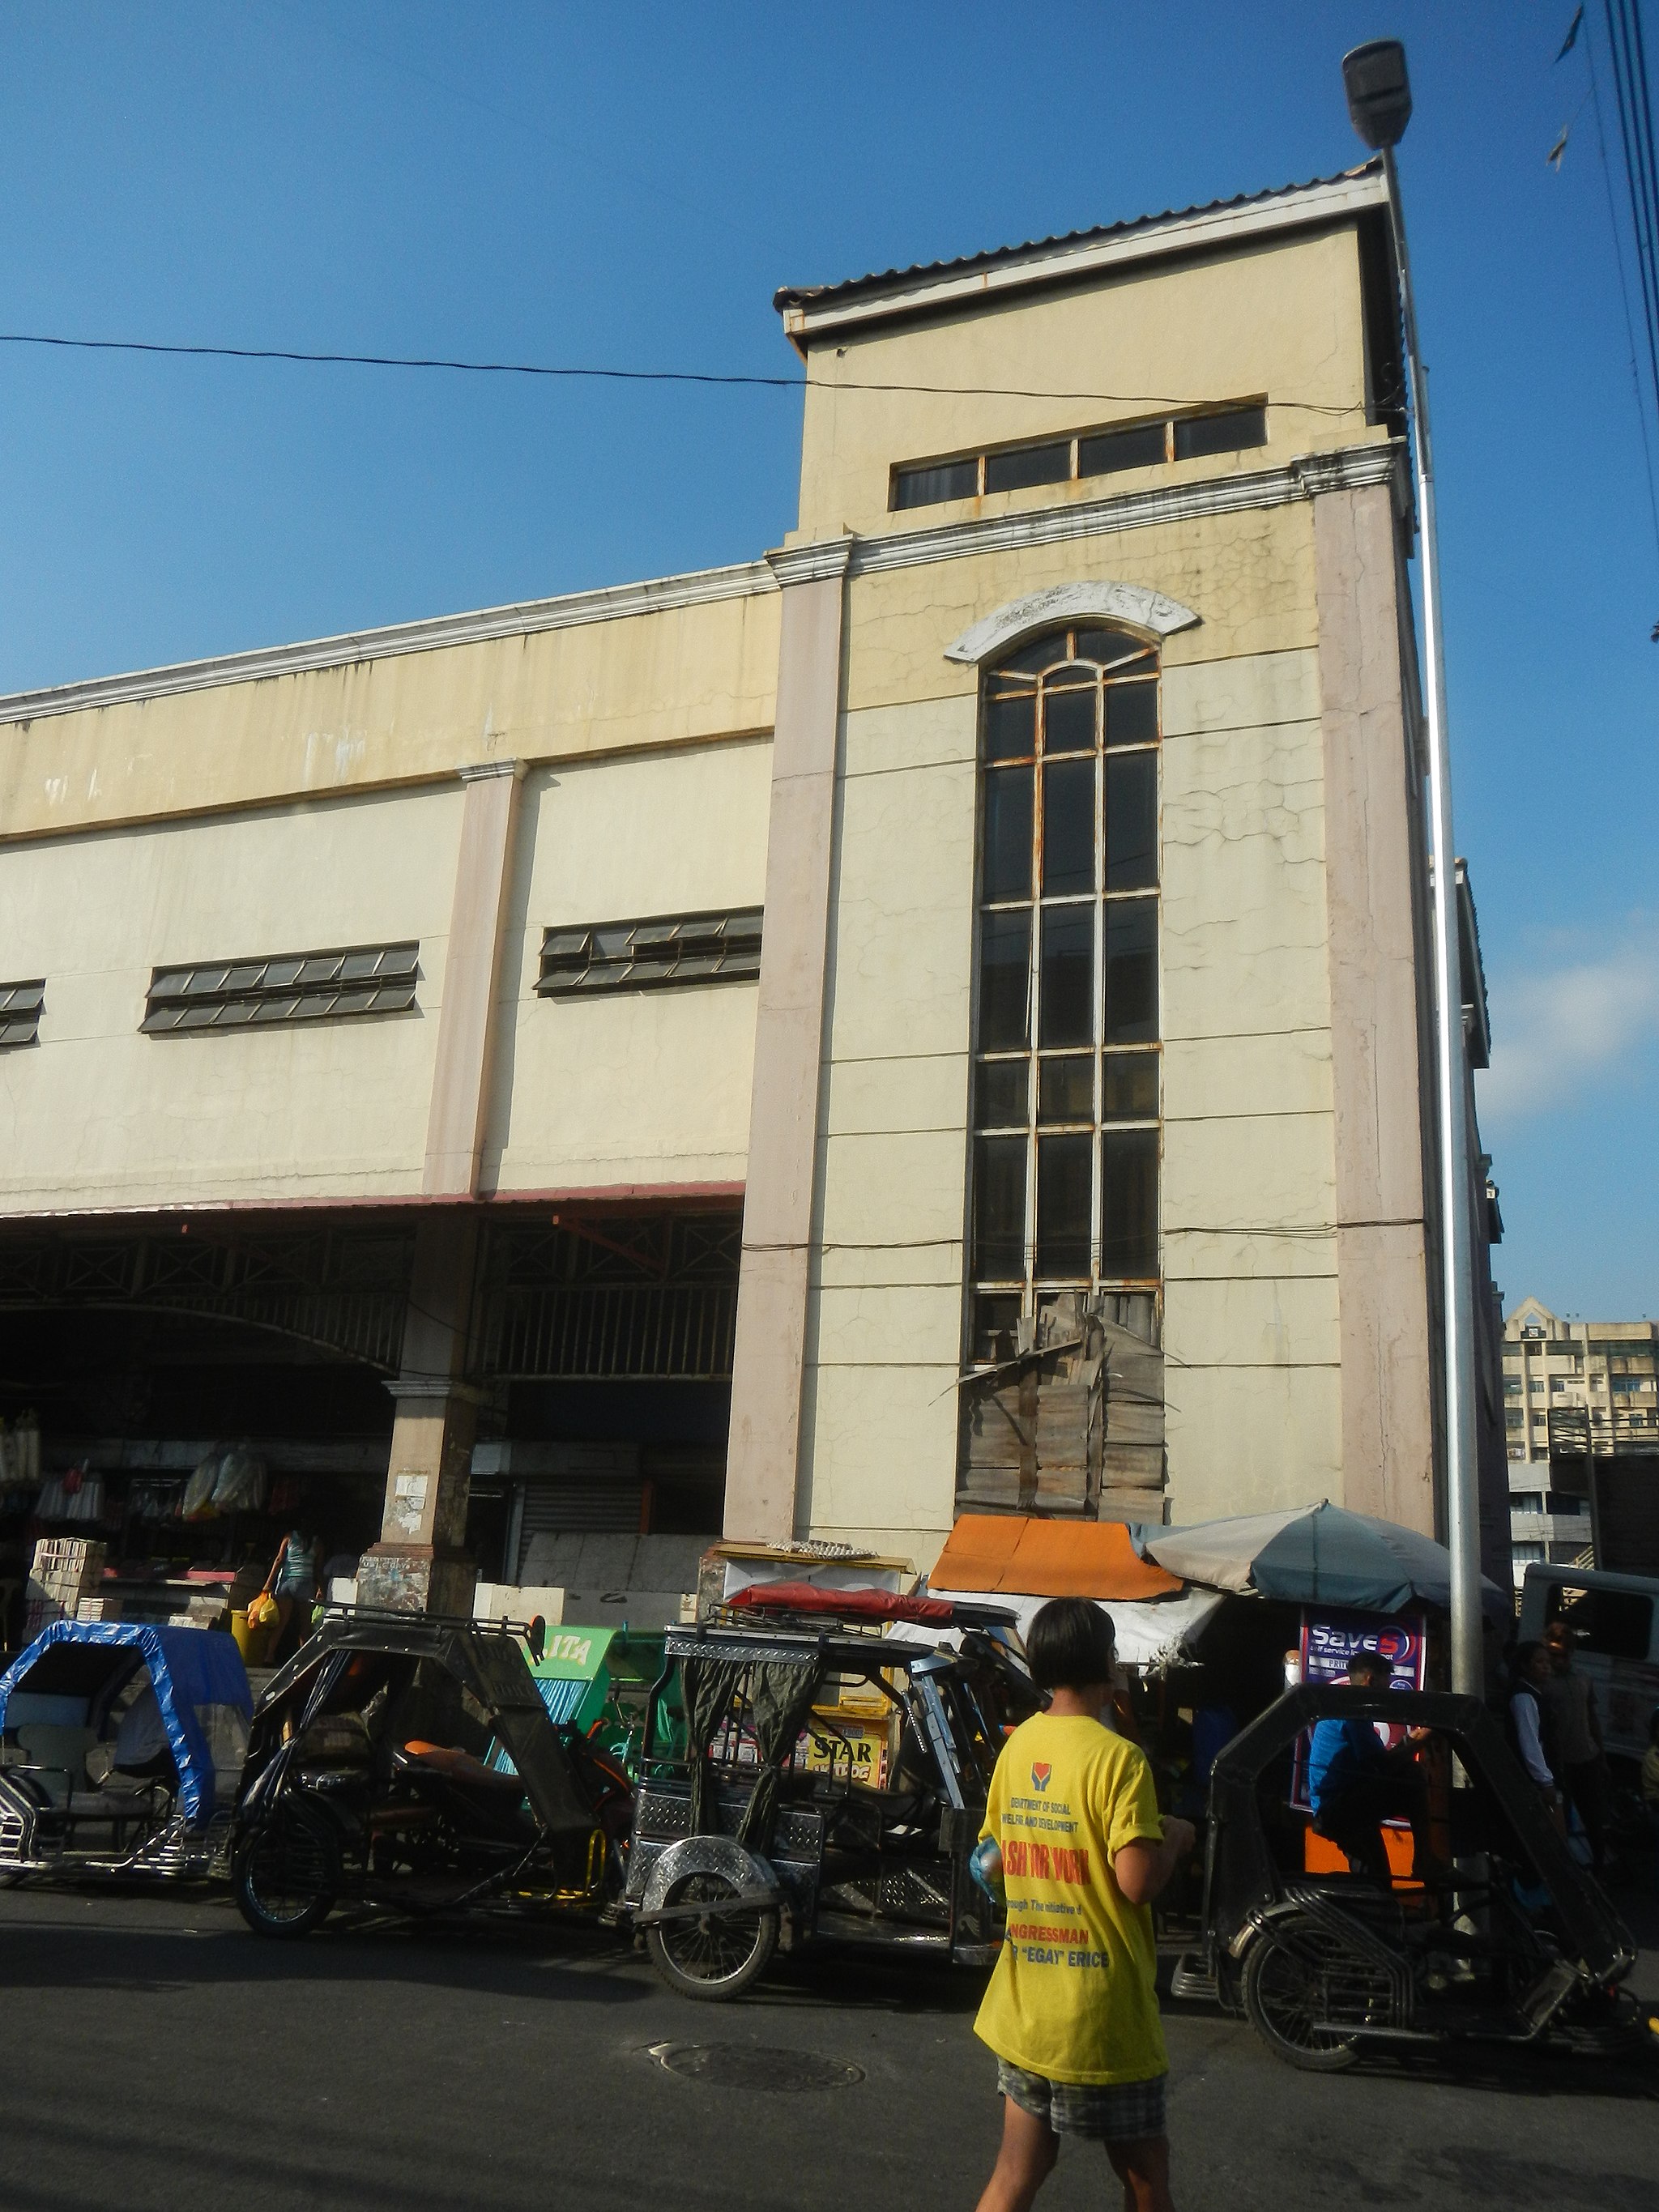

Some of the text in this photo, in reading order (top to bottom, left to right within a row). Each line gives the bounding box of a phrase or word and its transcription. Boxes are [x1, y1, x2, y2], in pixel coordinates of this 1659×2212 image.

[814, 1737, 872, 1762] STAR
[1025, 1815, 1038, 1828] AND
[1010, 1923, 1089, 1945] NGRESSMAN
[1068, 1950, 1110, 1968] ERICE
